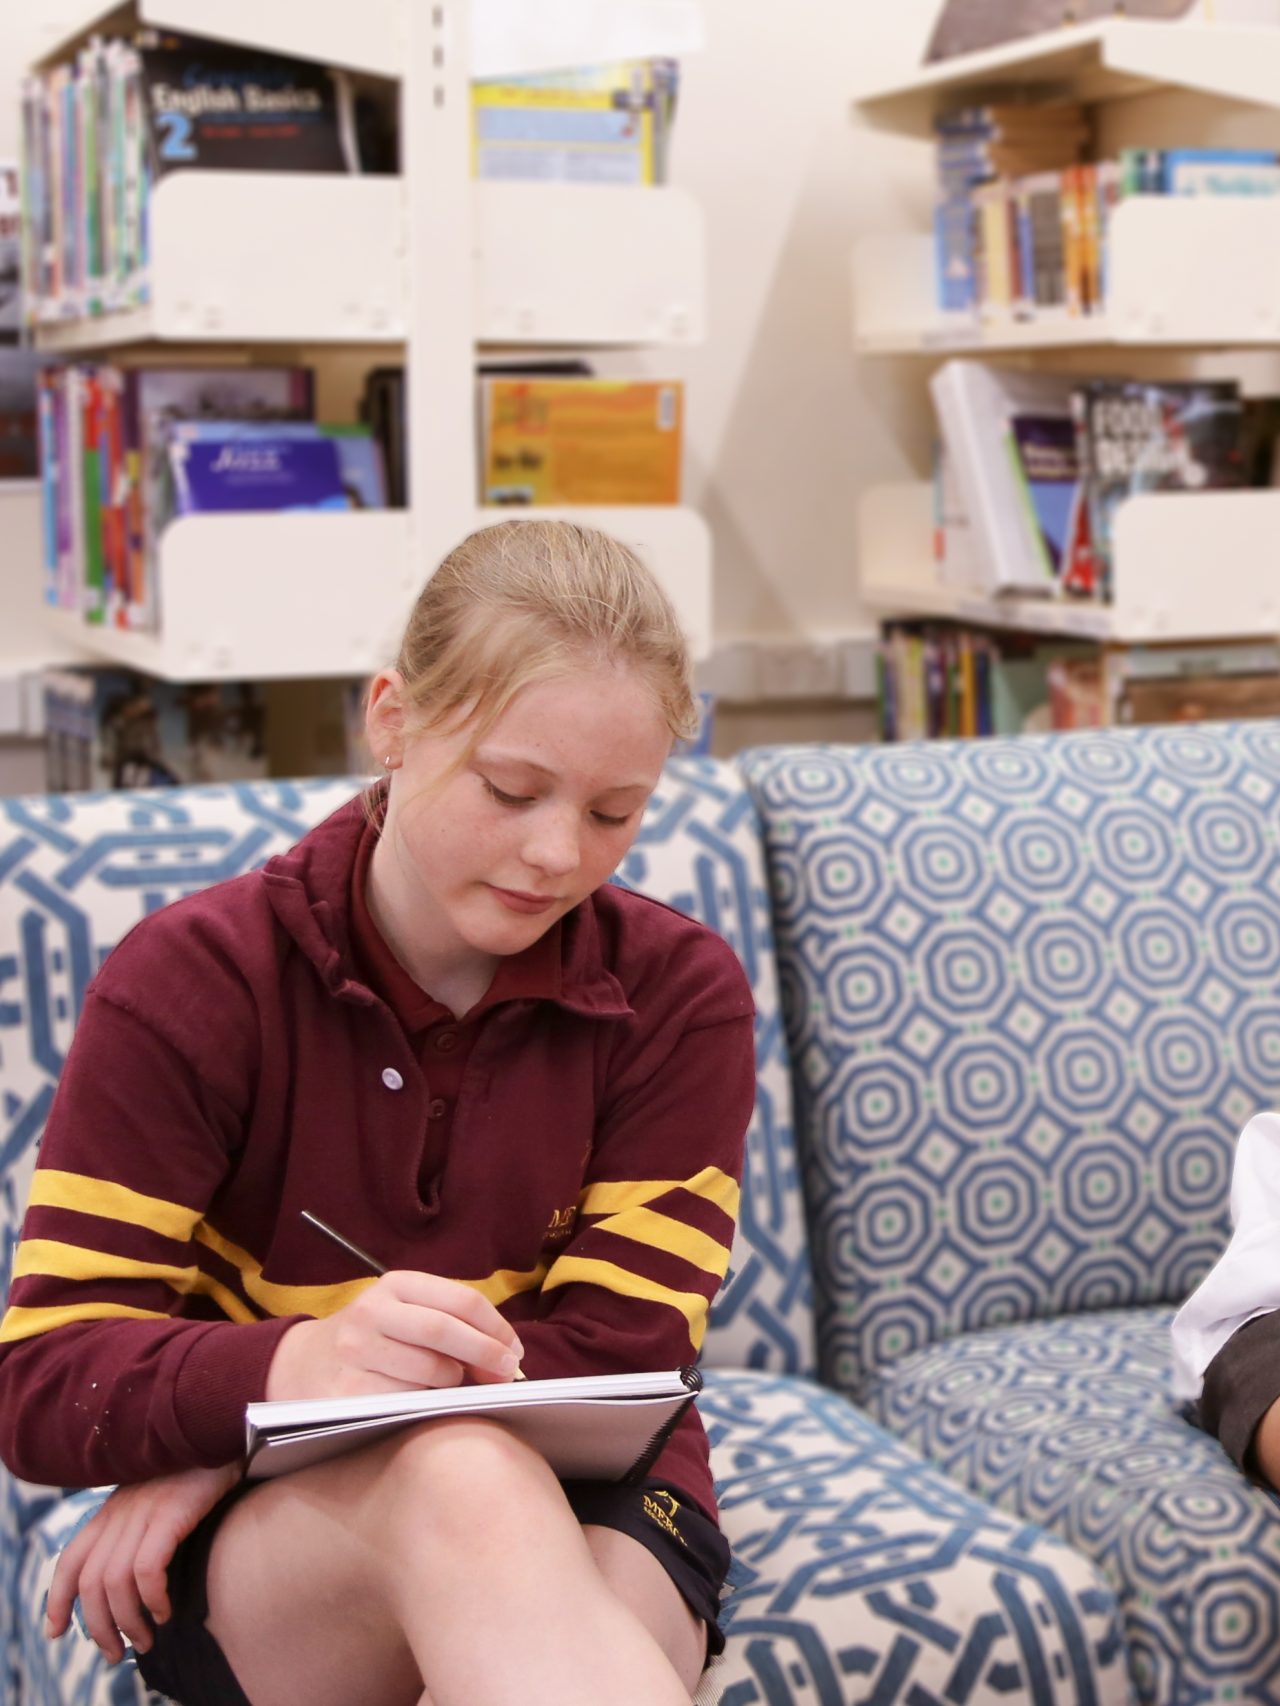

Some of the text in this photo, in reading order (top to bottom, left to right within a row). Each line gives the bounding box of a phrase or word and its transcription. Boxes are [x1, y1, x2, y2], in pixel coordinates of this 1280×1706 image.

[152, 83, 320, 118] English Basics
[156, 113, 197, 158] 2
